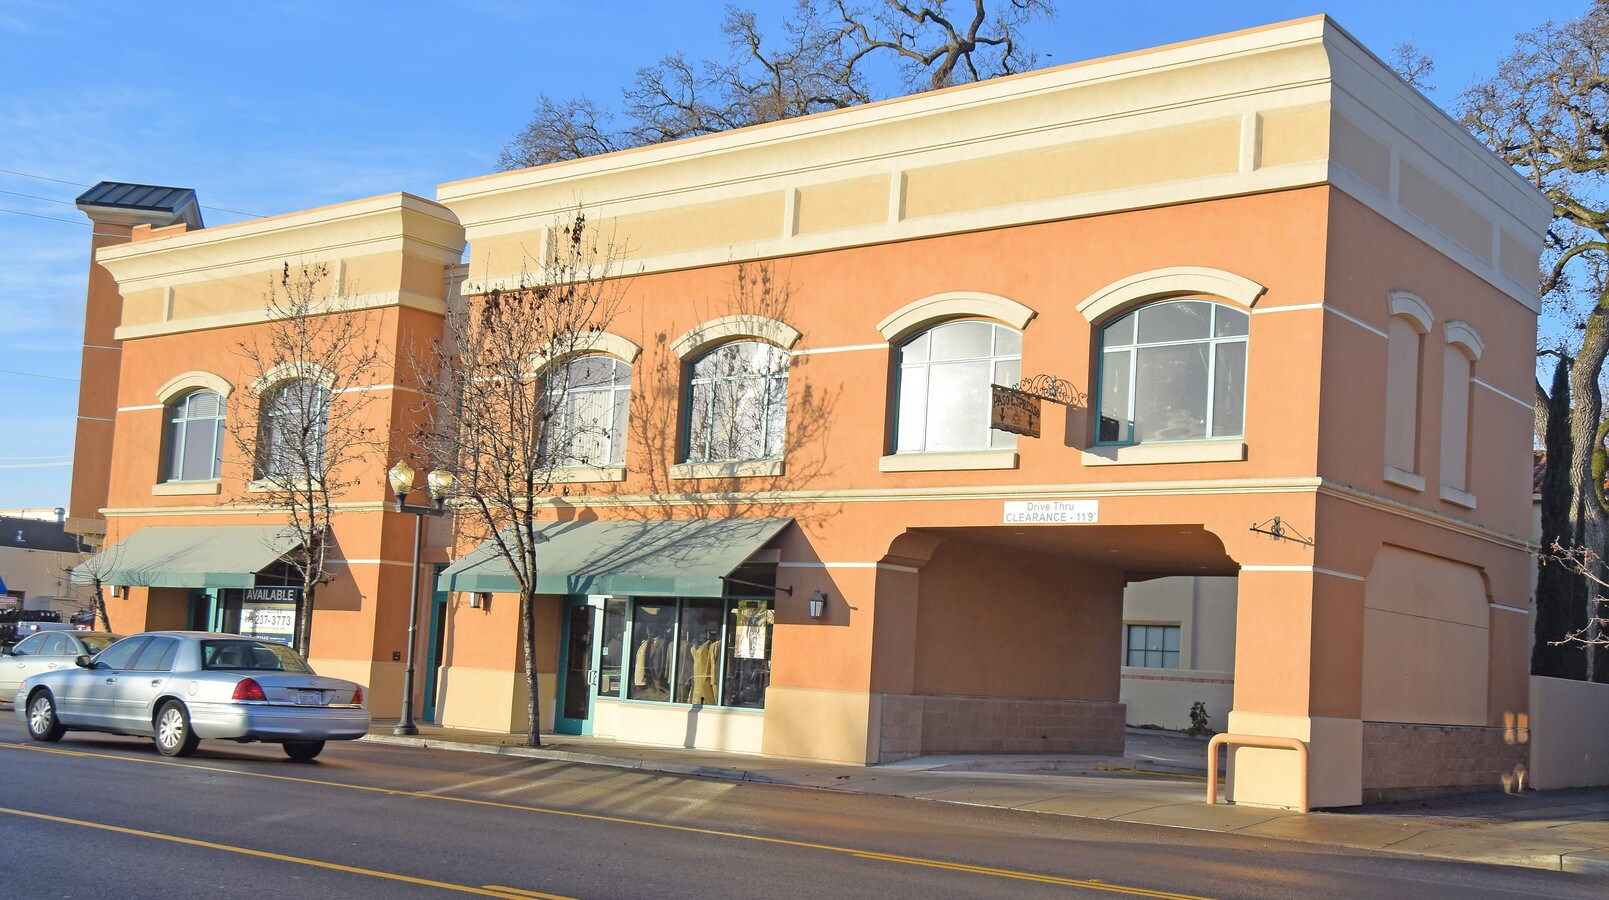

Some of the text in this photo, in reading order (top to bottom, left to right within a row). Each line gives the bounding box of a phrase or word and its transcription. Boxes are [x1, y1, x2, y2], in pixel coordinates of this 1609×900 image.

[993, 393, 1040, 419] PASO ESPRESSO
[1027, 501, 1075, 511] Drive Thru
[1006, 512, 1067, 522] CLEARANCE
[246, 589, 294, 601] AVAILABLE
[255, 614, 291, 626] 237-3773
